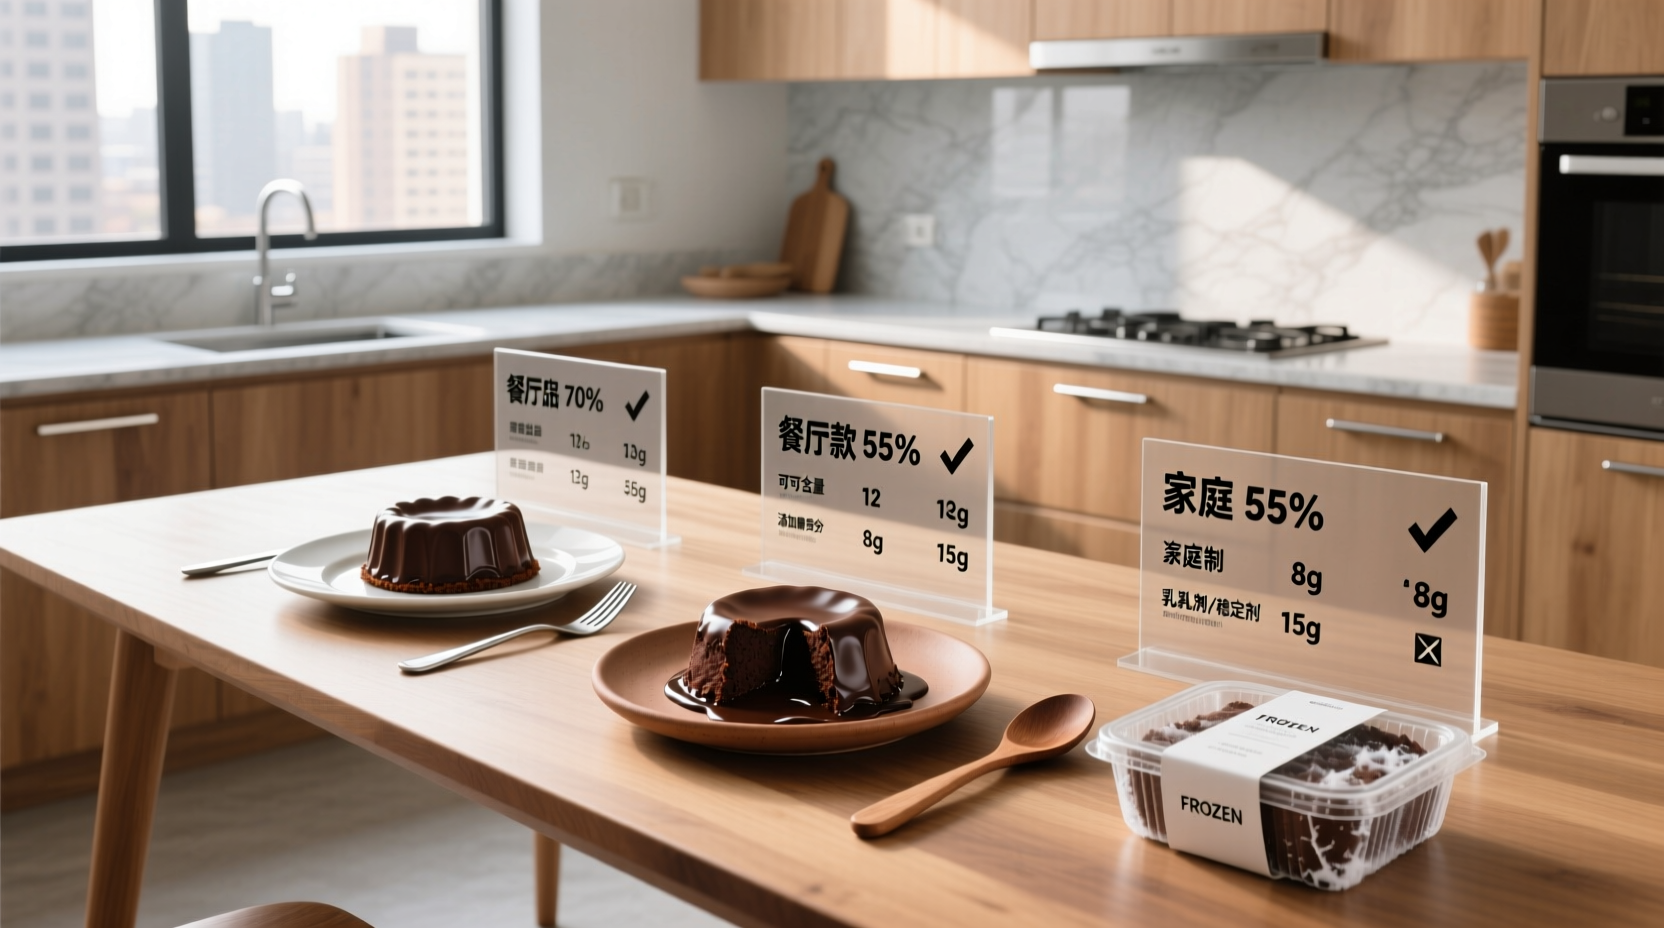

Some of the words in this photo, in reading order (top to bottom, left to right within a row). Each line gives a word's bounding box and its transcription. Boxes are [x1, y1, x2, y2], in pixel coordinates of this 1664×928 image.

[564, 385, 604, 412] 70%
[778, 415, 856, 461] 餐厅款
[863, 430, 921, 466] 55%
[778, 474, 825, 495] 可可含量
[862, 487, 881, 508] 12
[1162, 471, 1234, 521] 家庭
[1245, 485, 1324, 531] 55%
[863, 530, 883, 555] 8g
[937, 543, 969, 572] 15g
[1291, 561, 1322, 596] 8g
[1281, 611, 1321, 645] 15g
[1180, 795, 1243, 825] FROZEN
